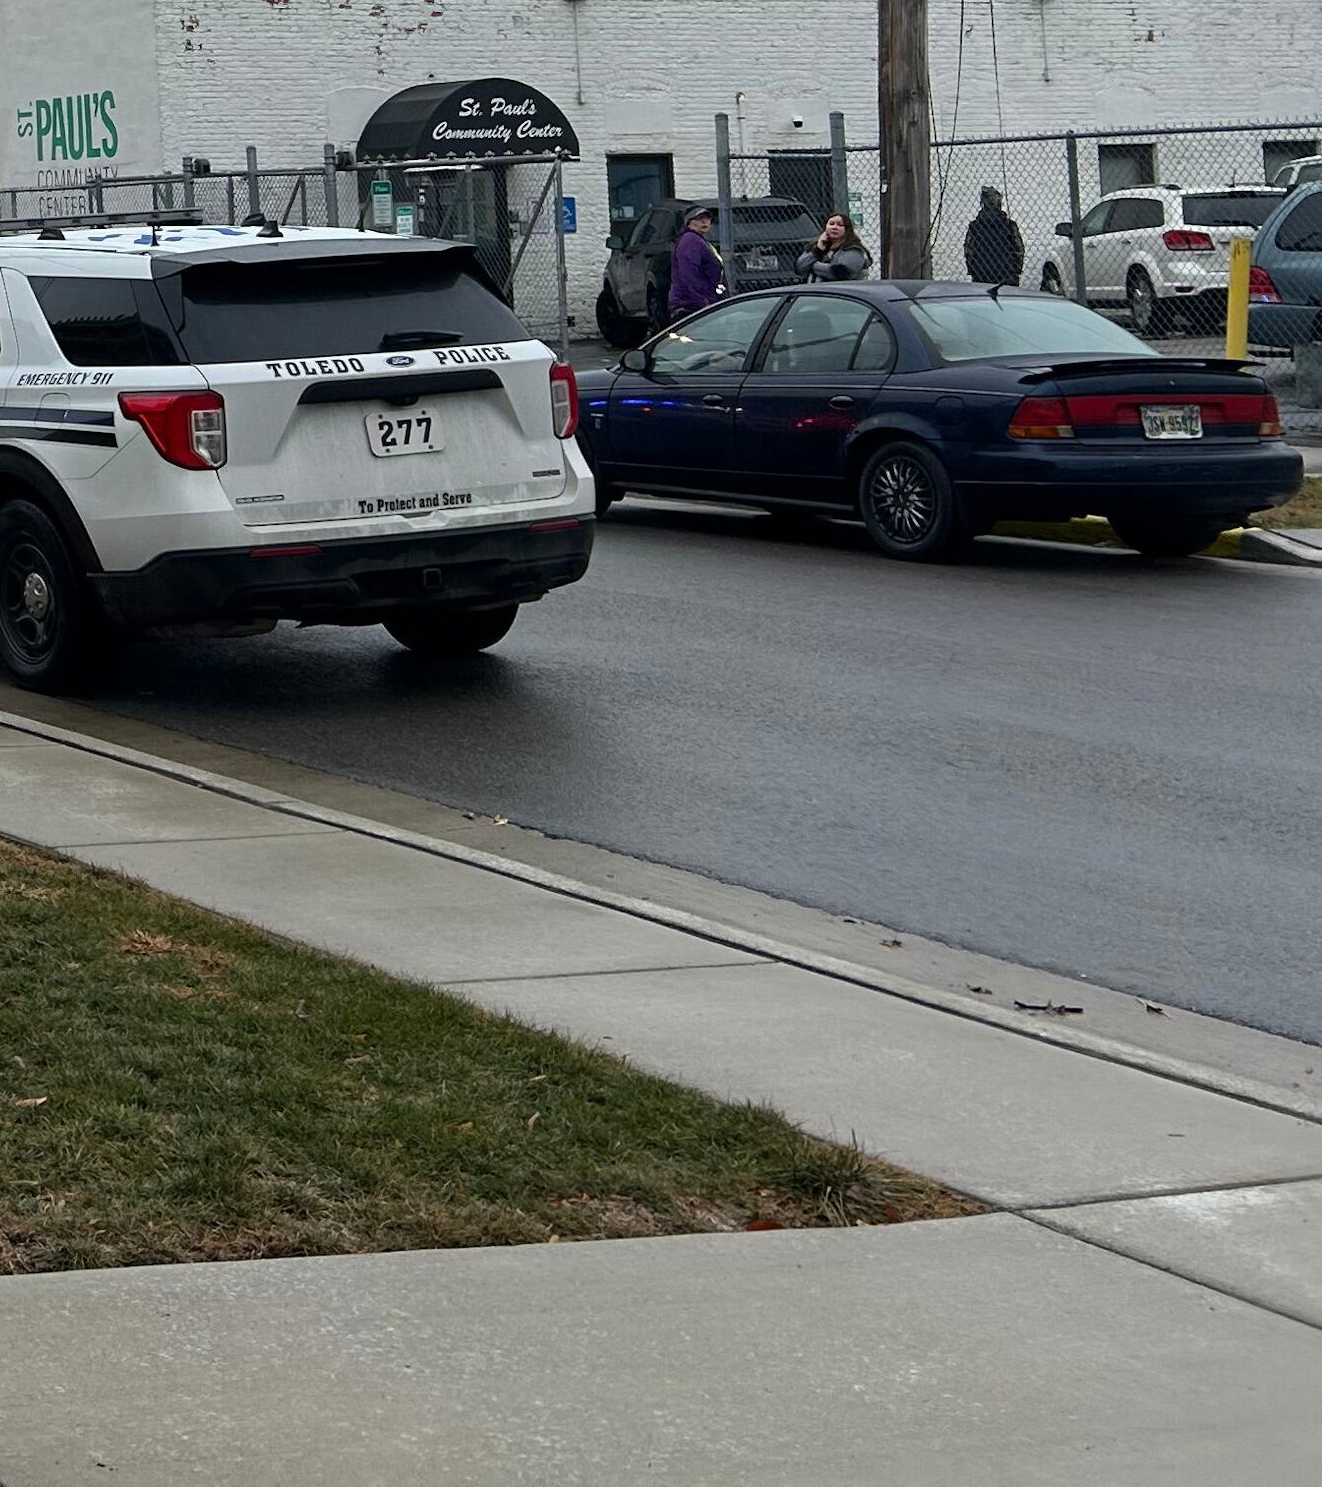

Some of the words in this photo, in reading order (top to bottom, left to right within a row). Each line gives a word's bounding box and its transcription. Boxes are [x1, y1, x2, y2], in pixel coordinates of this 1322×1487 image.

[459, 98, 483, 117] St.
[490, 97, 537, 117] Paul's
[17, 101, 34, 138] ST.
[35, 90, 118, 161] PAUL'S
[432, 121, 513, 143] Community
[517, 119, 563, 138] Center
[39, 195, 86, 217] CENTER
[266, 358, 365, 378] TOLEDO
[432, 346, 511, 365] POLICE
[16, 372, 92, 386] EMERGENCY
[90, 372, 115, 386] 911
[378, 417, 432, 447] 277
[358, 500, 373, 514] To
[376, 496, 417, 512] Protect
[419, 493, 439, 508] and
[442, 492, 472, 506] Serve
